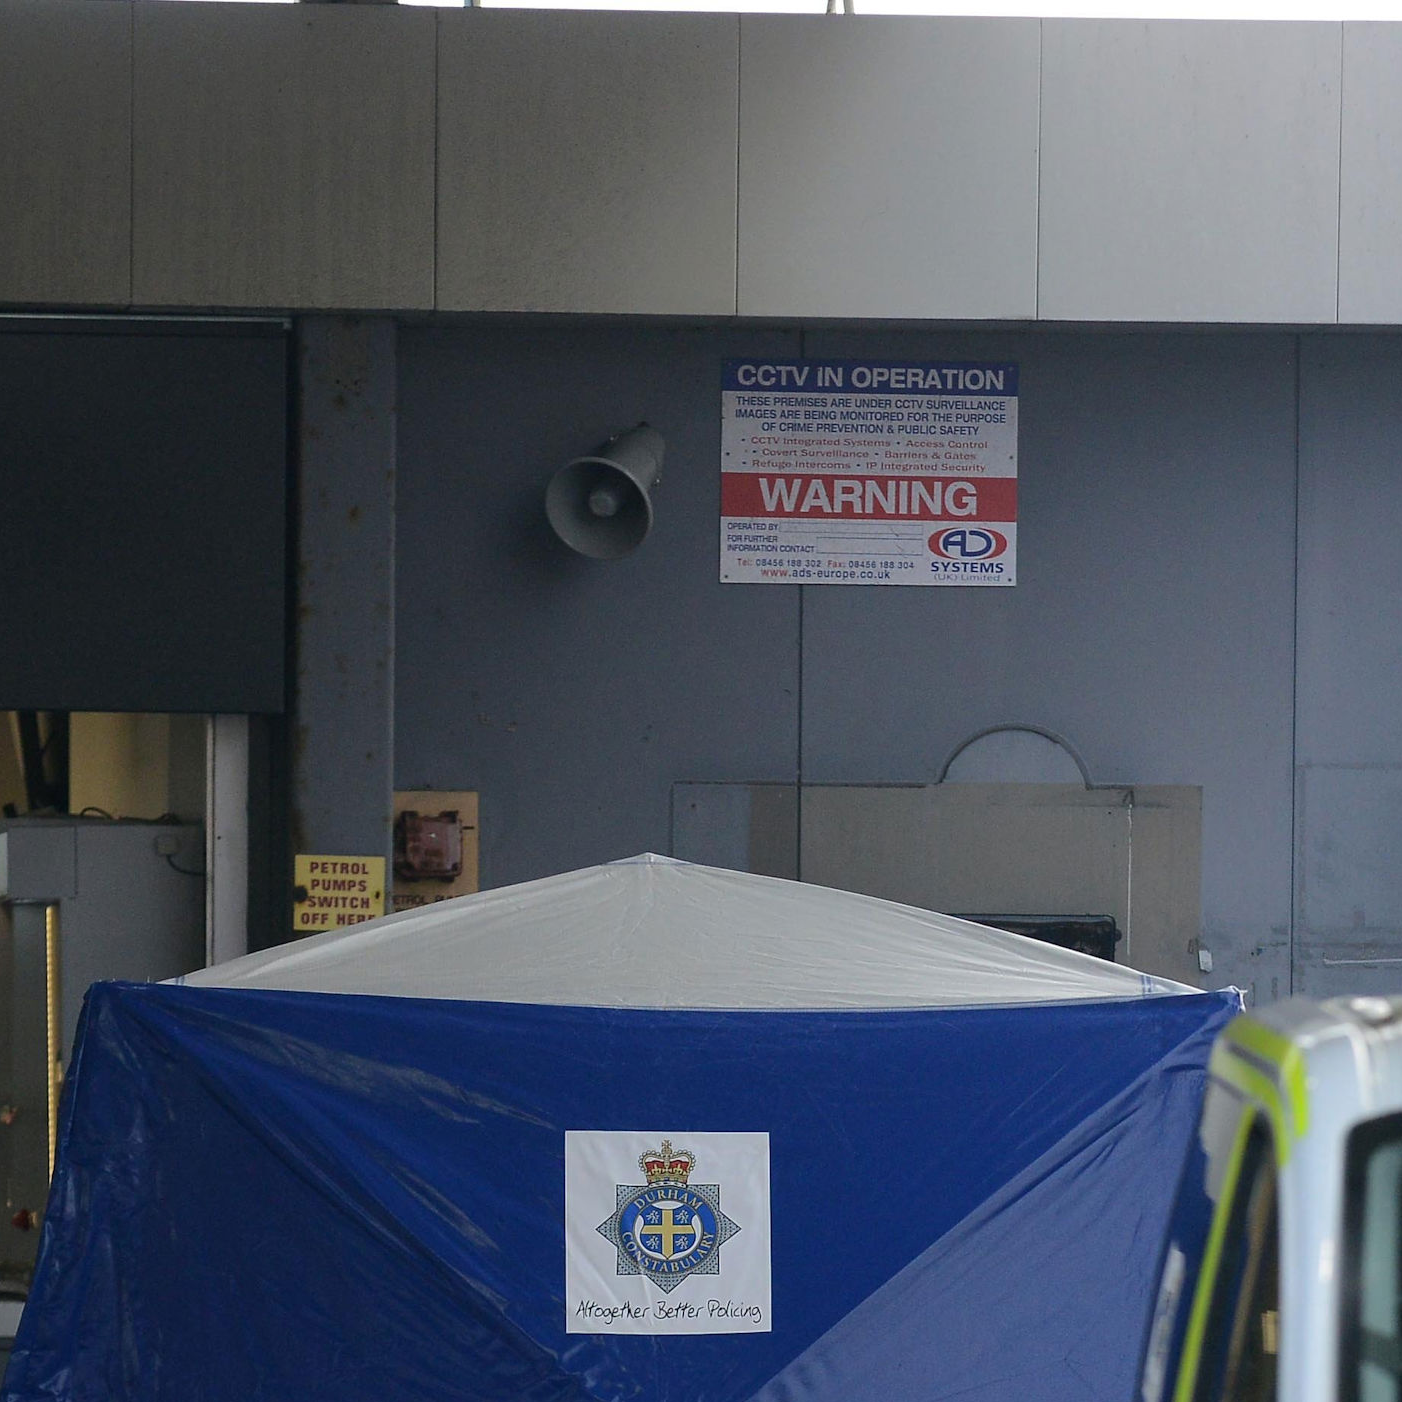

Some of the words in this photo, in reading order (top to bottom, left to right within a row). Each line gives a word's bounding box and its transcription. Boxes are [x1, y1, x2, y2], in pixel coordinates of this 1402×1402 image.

[737, 365, 809, 386] CCTV
[817, 367, 843, 387] IN
[851, 367, 1004, 390] OPERATION
[736, 396, 770, 406] THESE
[773, 397, 828, 408] PREMISES
[830, 398, 852, 408] ARE
[855, 399, 892, 408] UNDER
[895, 399, 923, 409] CCTV
[926, 400, 1006, 411] SURVEILLANCE
[735, 409, 777, 419] IMAGES
[780, 410, 801, 420] ARE
[804, 411, 837, 420] BEING
[840, 411, 904, 421] MONITORED
[908, 412, 929, 422] FOR
[932, 413, 952, 422] THE
[955, 413, 1006, 423] PURPOSE
[762, 422, 776, 431] OF
[779, 422, 813, 432] CRIME
[817, 423, 883, 434] PREVENTION
[887, 425, 894, 434] &
[898, 425, 936, 435] PUBLIC
[940, 426, 979, 435] SAFETY
[783, 438, 840, 446] Integrated
[843, 439, 891, 448] Systems
[906, 440, 944, 448] Access
[948, 440, 988, 448] Control
[762, 448, 797, 456] Covert
[801, 449, 869, 458] Surveillance
[884, 451, 928, 459] Barriers
[944, 451, 977, 460] Gates
[752, 460, 791, 470] Refuge
[795, 461, 851, 469] Intercoms
[881, 462, 937, 471] Integrated
[941, 463, 986, 473] Security
[758, 477, 978, 517] WARNING
[727, 522, 766, 530] OPERATED
[768, 523, 779, 531] BY
[743, 535, 778, 543] FURTHER
[727, 544, 778, 553] INFORMATION
[779, 545, 815, 553] CONTACT
[755, 559, 784, 567] 08456
[848, 560, 877, 569] 08456
[897, 561, 914, 569] 304
[931, 561, 1004, 574] SYSTEMS
[761, 568, 891, 580] www.ads-europe.co.uk
[934, 574, 958, 582] (UK)
[961, 574, 1001, 582] Limited
[310, 862, 369, 875] PETROL
[311, 879, 367, 892] PUMPS
[308, 896, 369, 908] SWITCH
[301, 913, 329, 925] OFF
[634, 1189, 703, 1210] DURHAM
[622, 1231, 714, 1272] CONSTABULARY
[576, 1300, 650, 1324] Altogether
[653, 1301, 704, 1320] Better
[707, 1299, 762, 1323] Policing
